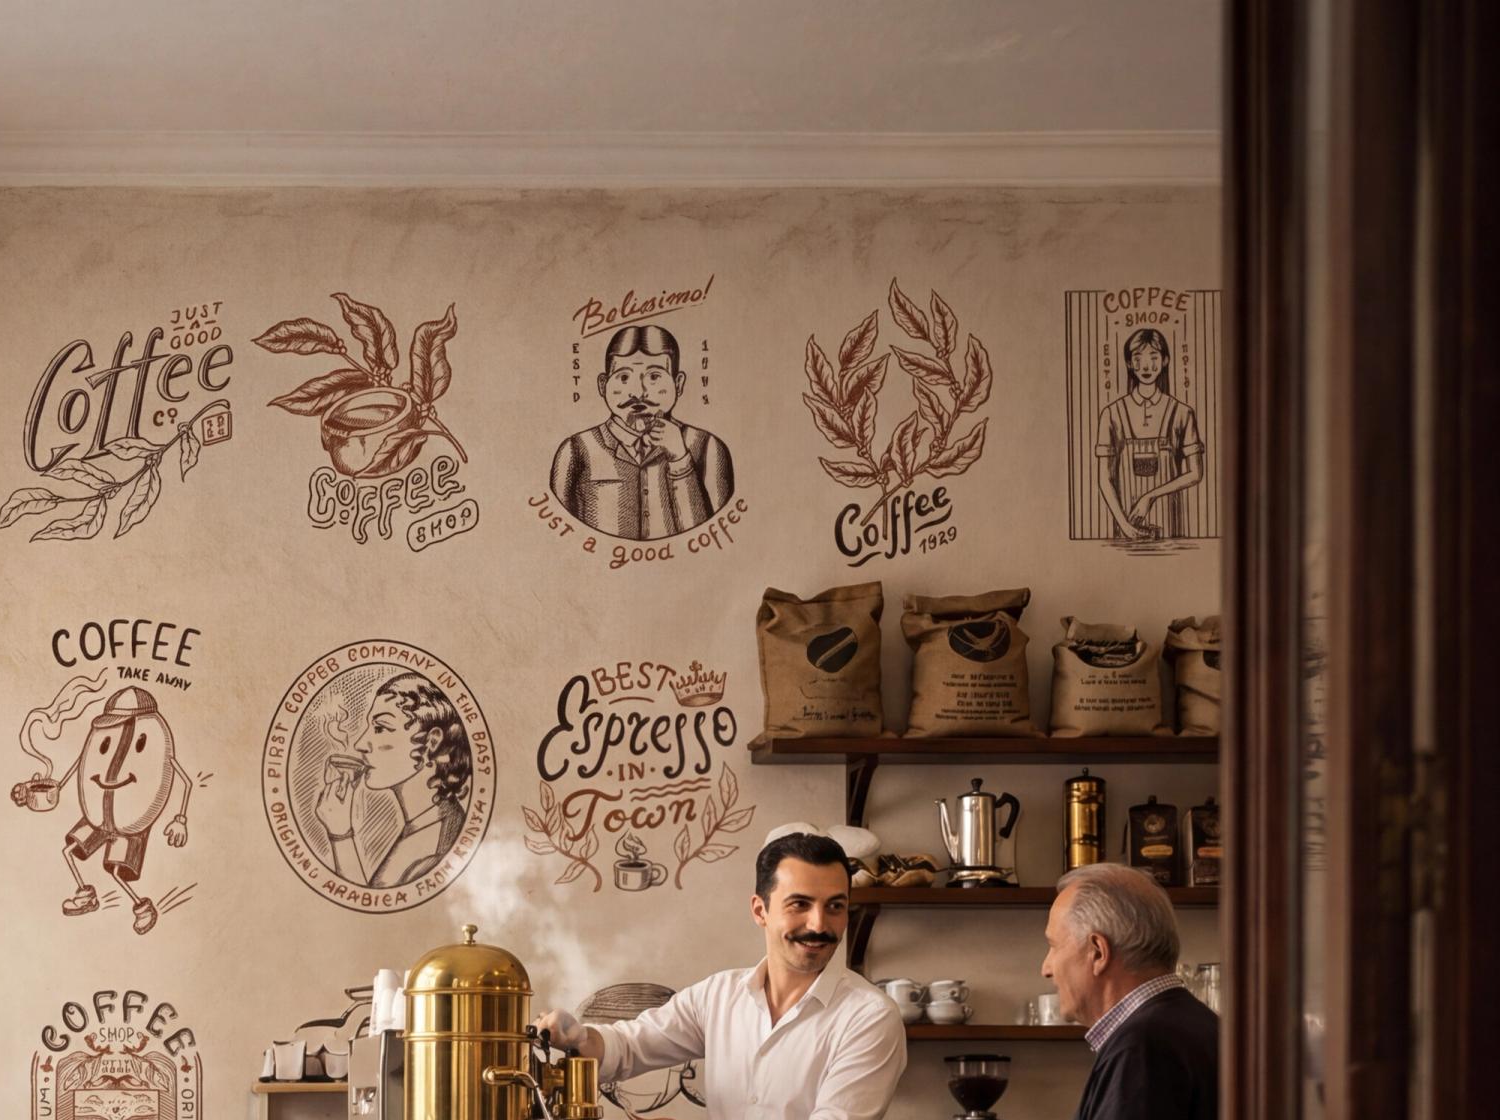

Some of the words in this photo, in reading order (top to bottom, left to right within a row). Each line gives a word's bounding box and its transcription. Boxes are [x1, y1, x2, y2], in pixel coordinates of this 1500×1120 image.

[170, 301, 224, 324] JUST
[23, 327, 234, 472] Coffee
[582, 536, 597, 554] a
[609, 543, 675, 570] good
[687, 498, 749, 555] coffee
[834, 486, 952, 562] Coffee
[51, 618, 202, 668] COFFEE
[347, 644, 436, 671] COMPANY
[436, 670, 457, 689] IN
[117, 666, 151, 682] TAKE
[155, 672, 192, 692] AWAY
[591, 662, 677, 697] BEST
[536, 674, 738, 783] Espresso
[617, 761, 646, 782] IN
[562, 788, 697, 842] Town
[41, 989, 197, 1058] COFFEE
